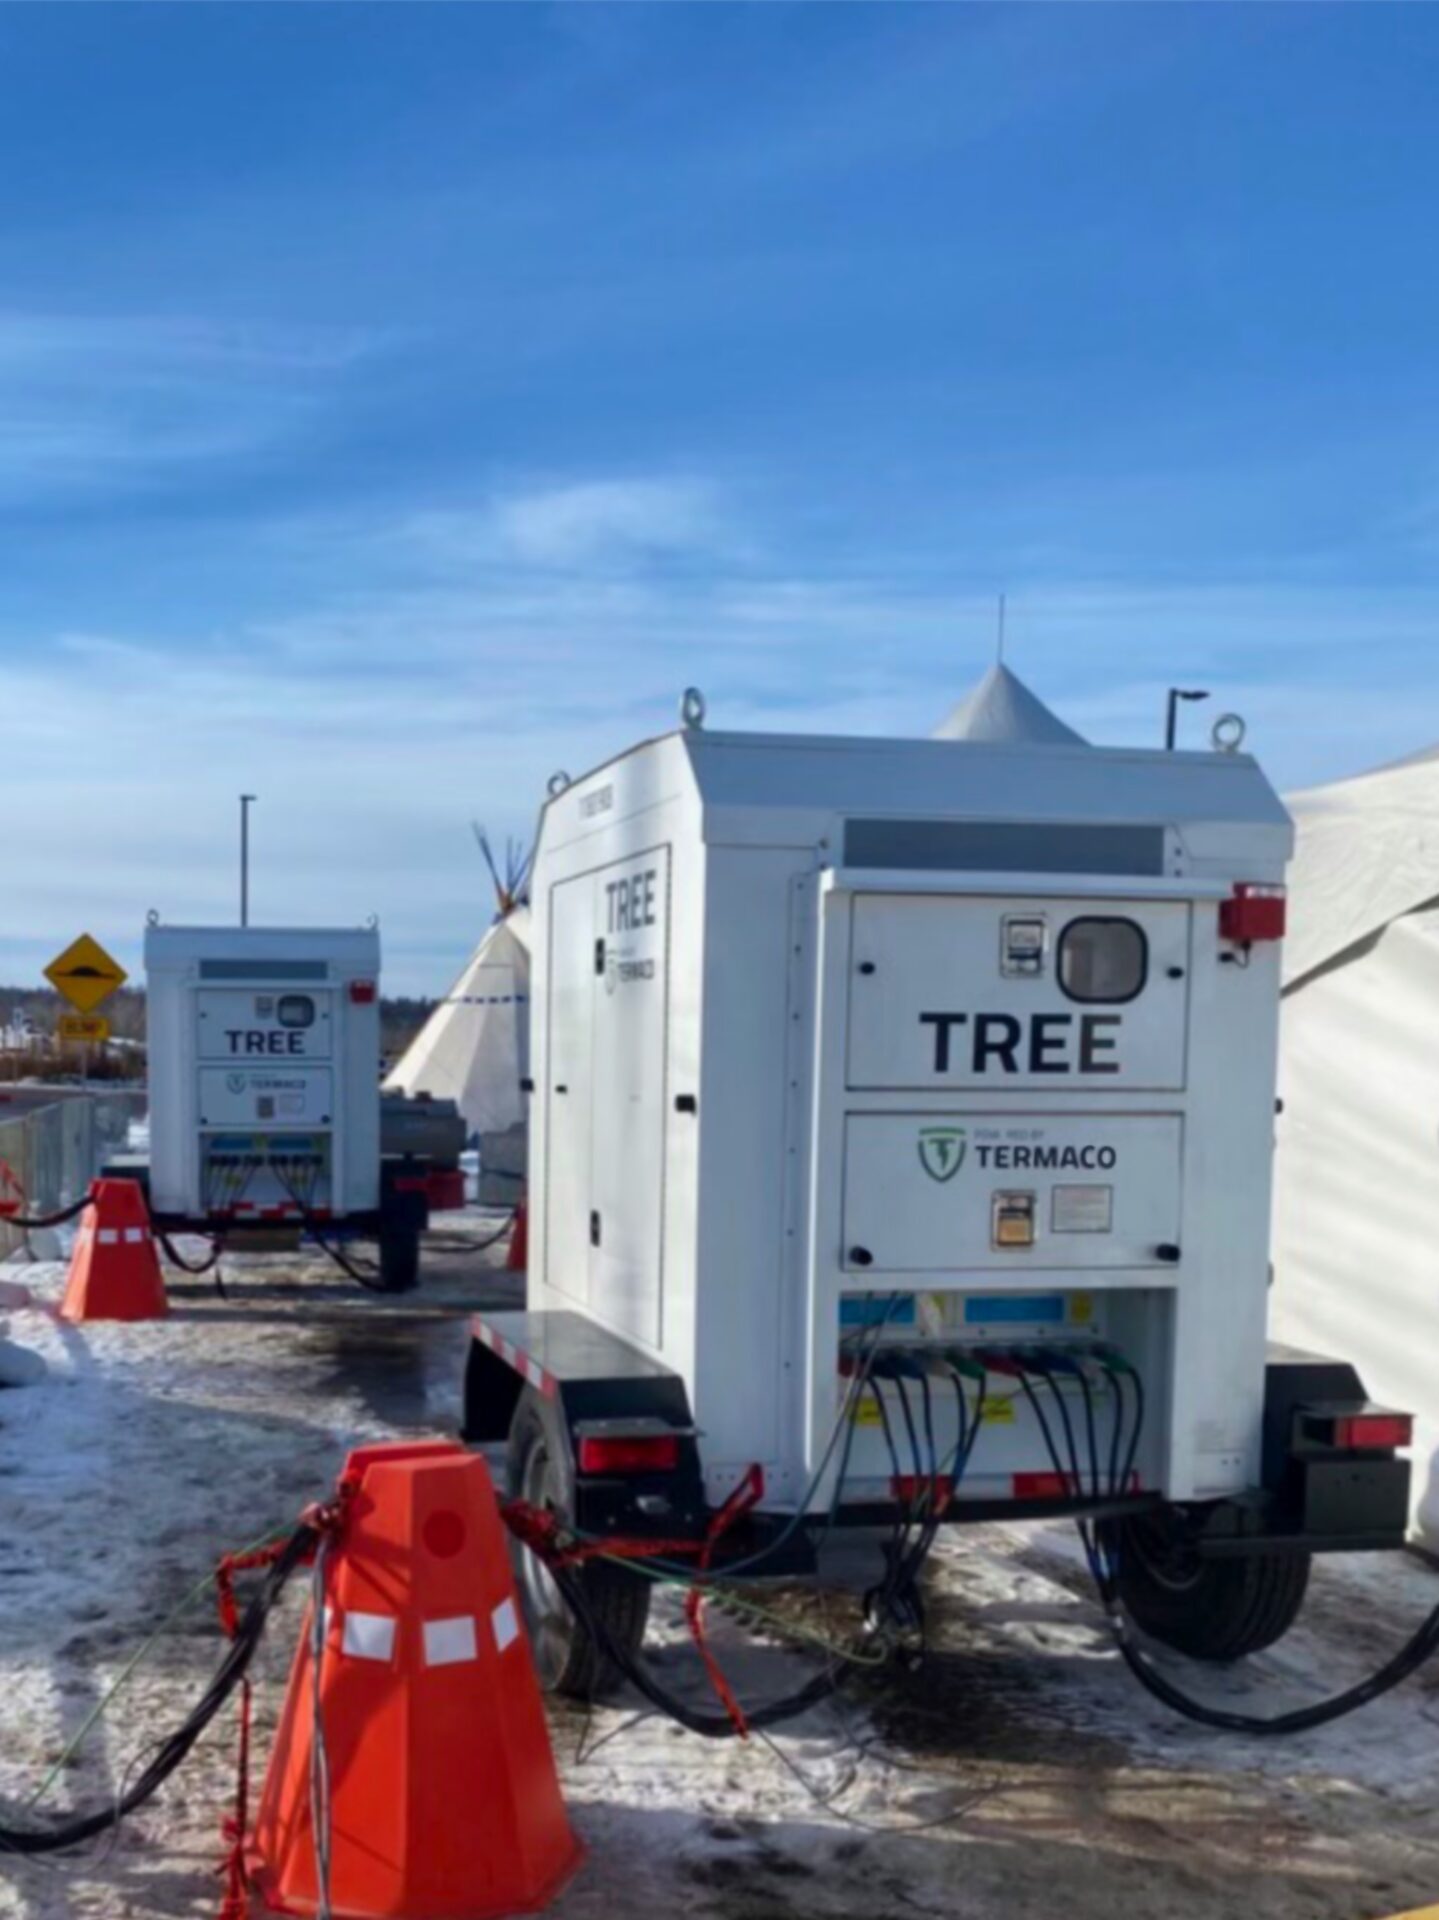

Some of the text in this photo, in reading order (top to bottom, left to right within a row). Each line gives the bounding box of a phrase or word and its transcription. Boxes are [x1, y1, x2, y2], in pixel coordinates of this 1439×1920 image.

[606, 869, 655, 933] TREE
[224, 1030, 305, 1054] TREE
[918, 1012, 1122, 1074] TREE
[974, 1144, 1117, 1170] TERMACO
